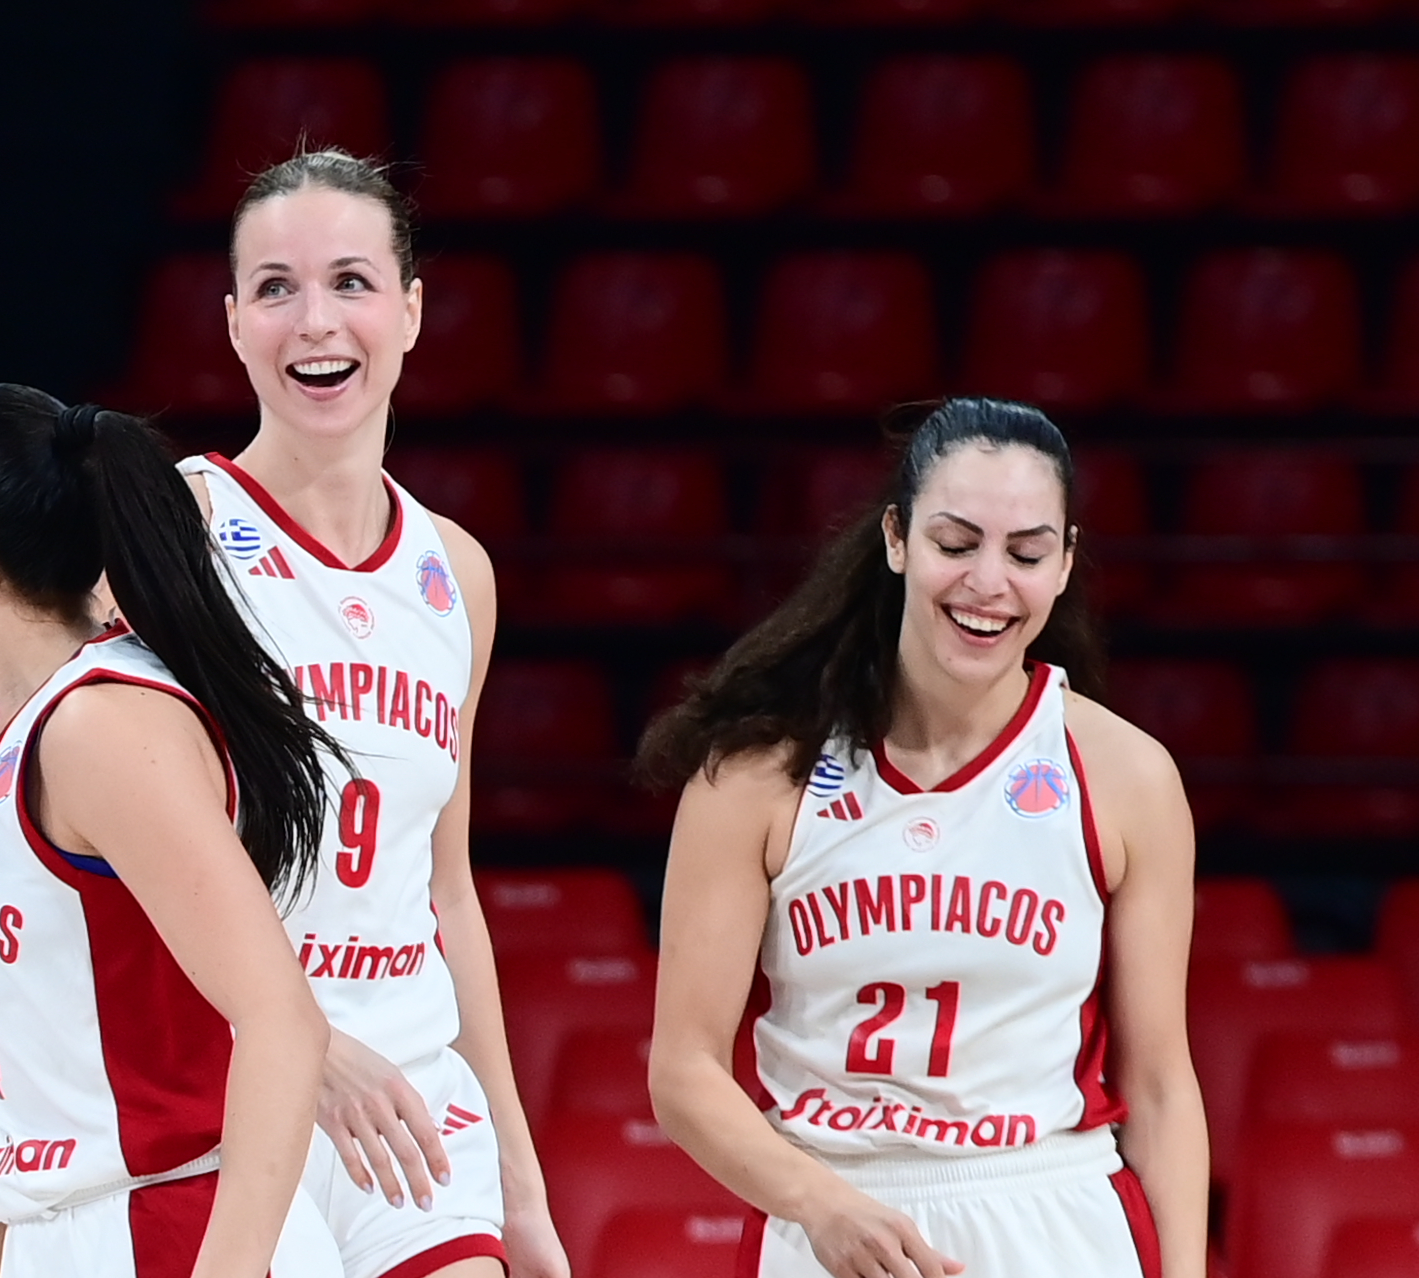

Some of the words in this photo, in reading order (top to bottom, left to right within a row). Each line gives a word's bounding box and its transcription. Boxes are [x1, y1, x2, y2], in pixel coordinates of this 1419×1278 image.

[336, 778, 381, 889] 9
[298, 933, 425, 980] iximan
[789, 874, 1065, 957] OLYMPIACOS
[846, 980, 960, 1078] 21
[781, 1088, 1037, 1147] Stoiximan
